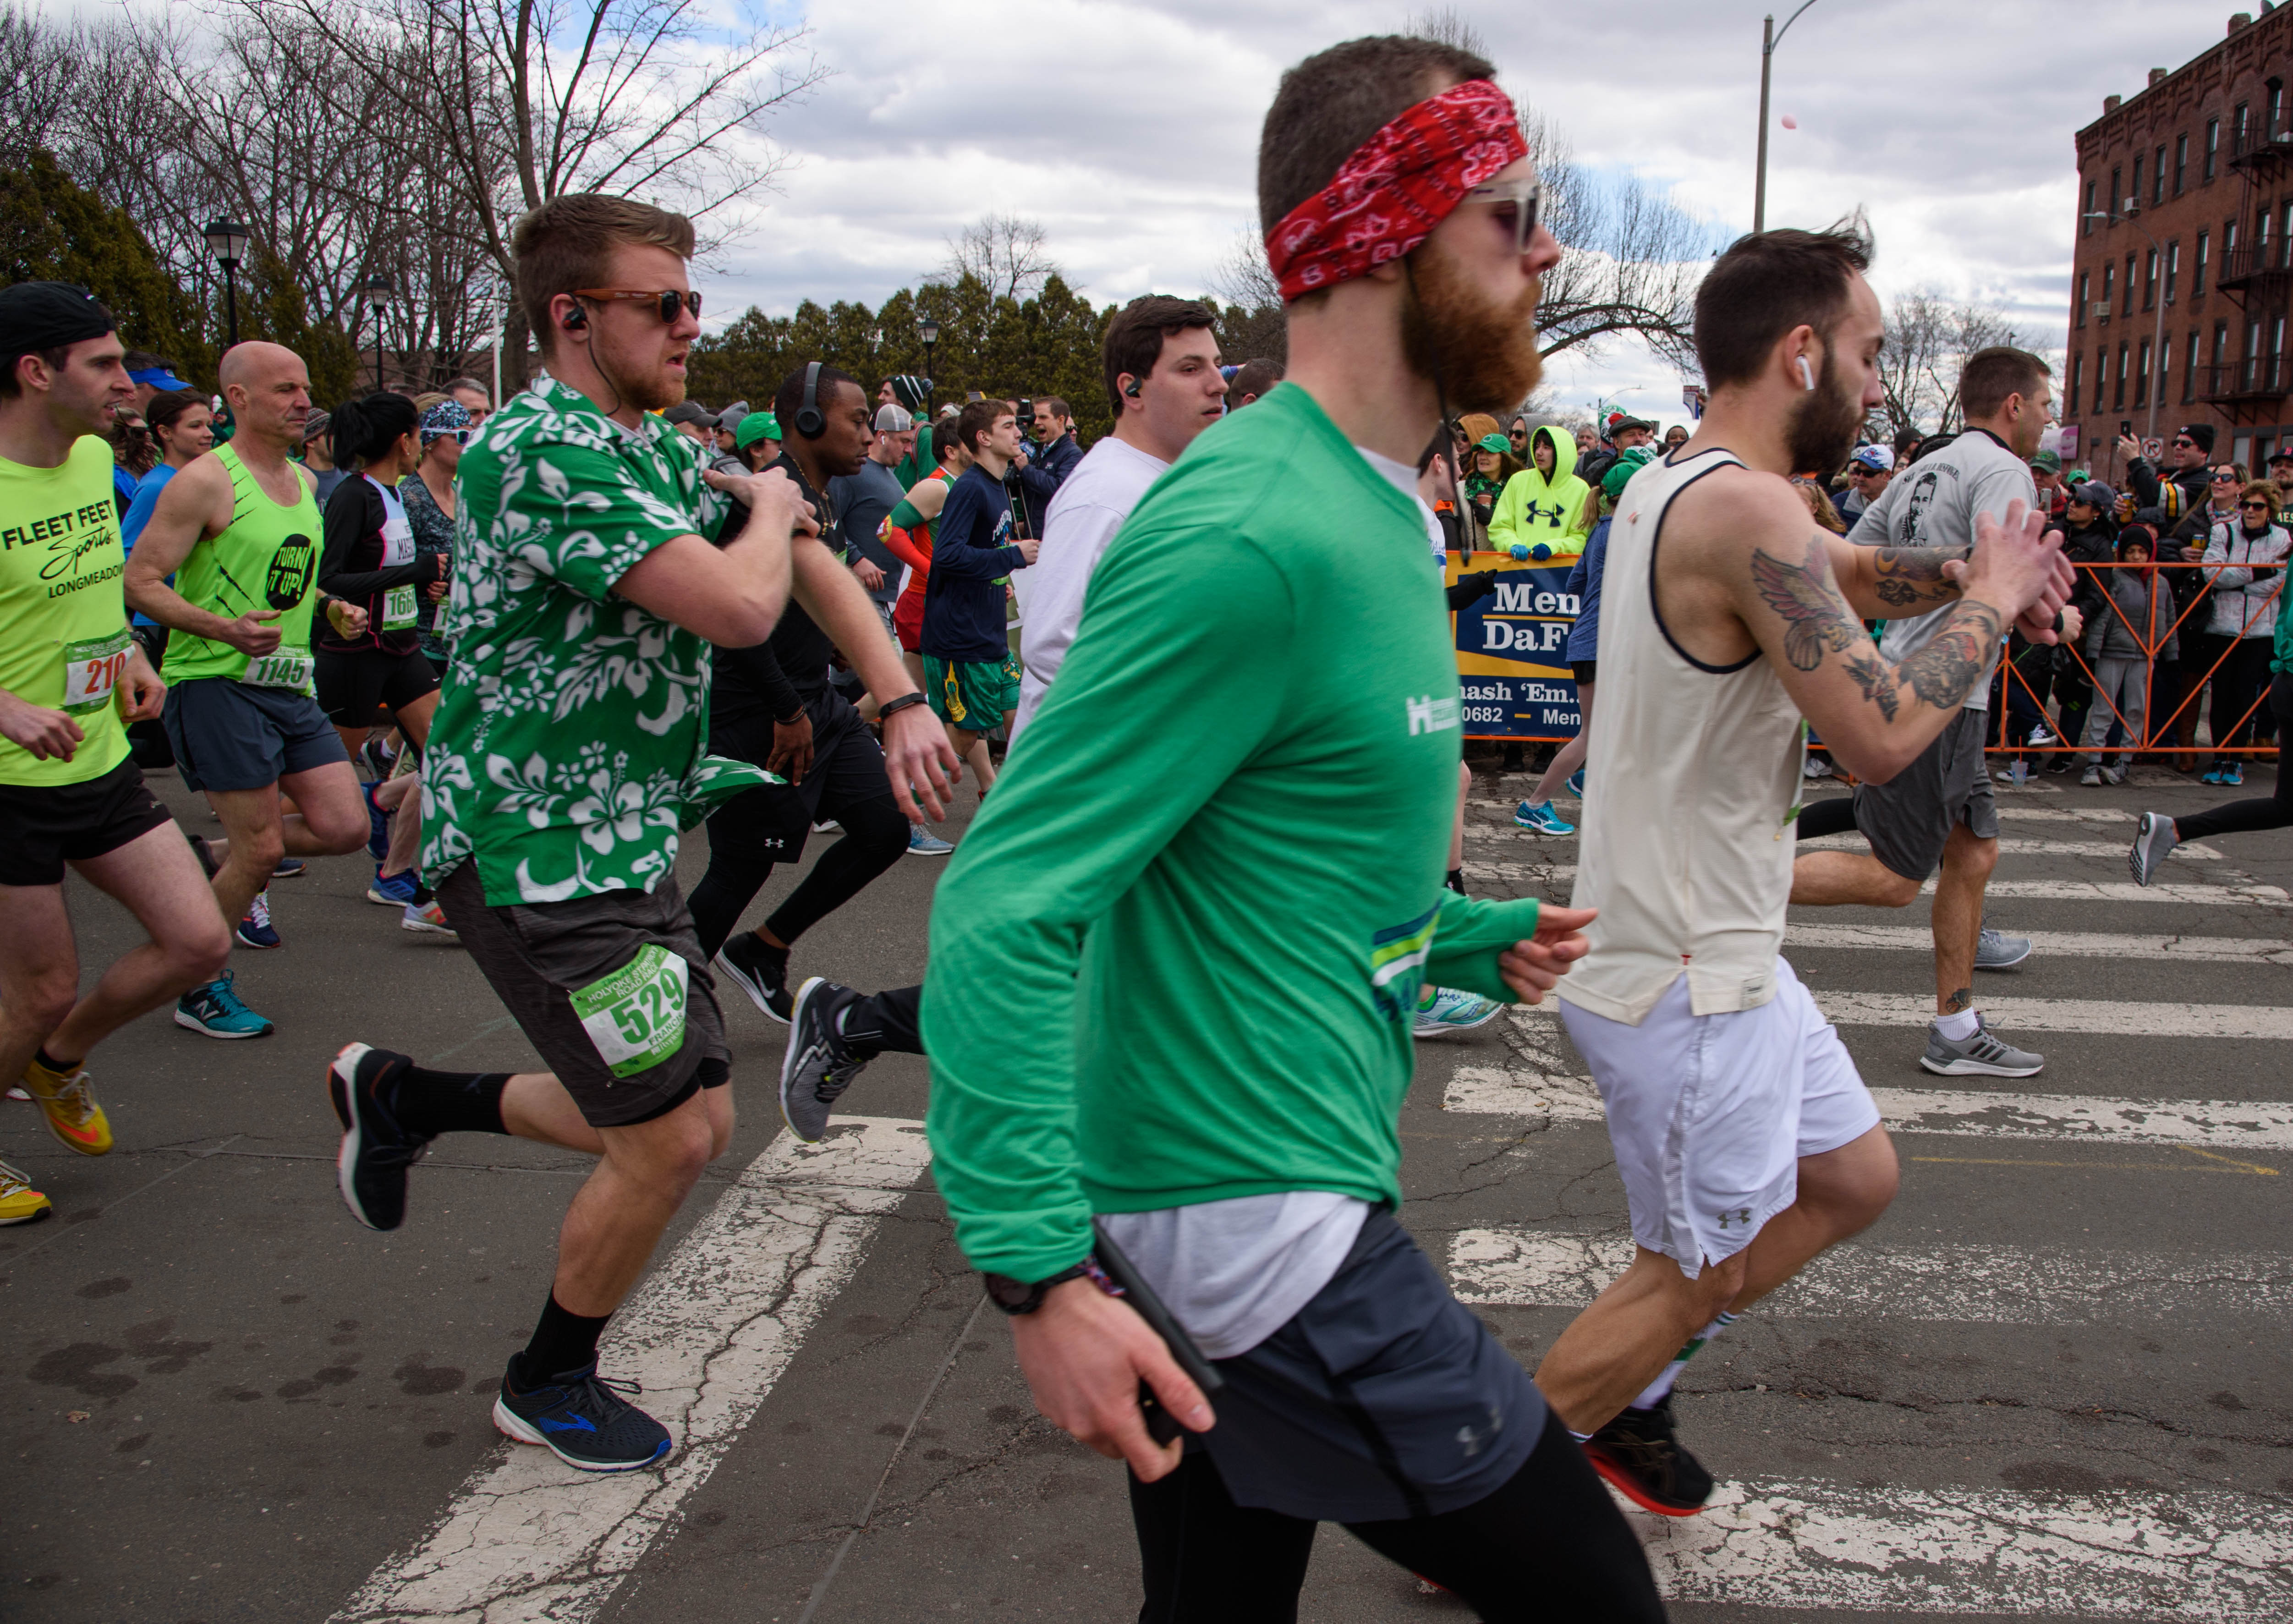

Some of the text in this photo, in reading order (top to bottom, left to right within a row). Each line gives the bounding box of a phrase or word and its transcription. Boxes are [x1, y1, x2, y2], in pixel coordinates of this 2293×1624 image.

[1, 499, 114, 550] FLEET FEET
[39, 525, 116, 580] Sports
[275, 546, 308, 570] TURN
[1492, 582, 1580, 615] Men
[1482, 620, 1569, 652] DaF
[84, 652, 126, 695] 210
[256, 658, 306, 684] 1145
[1462, 707, 1503, 722] 0682
[1543, 709, 1580, 725] Men
[587, 974, 632, 1004] HOLYOKE
[616, 977, 643, 999] ROAD
[609, 968, 685, 1045] 529
